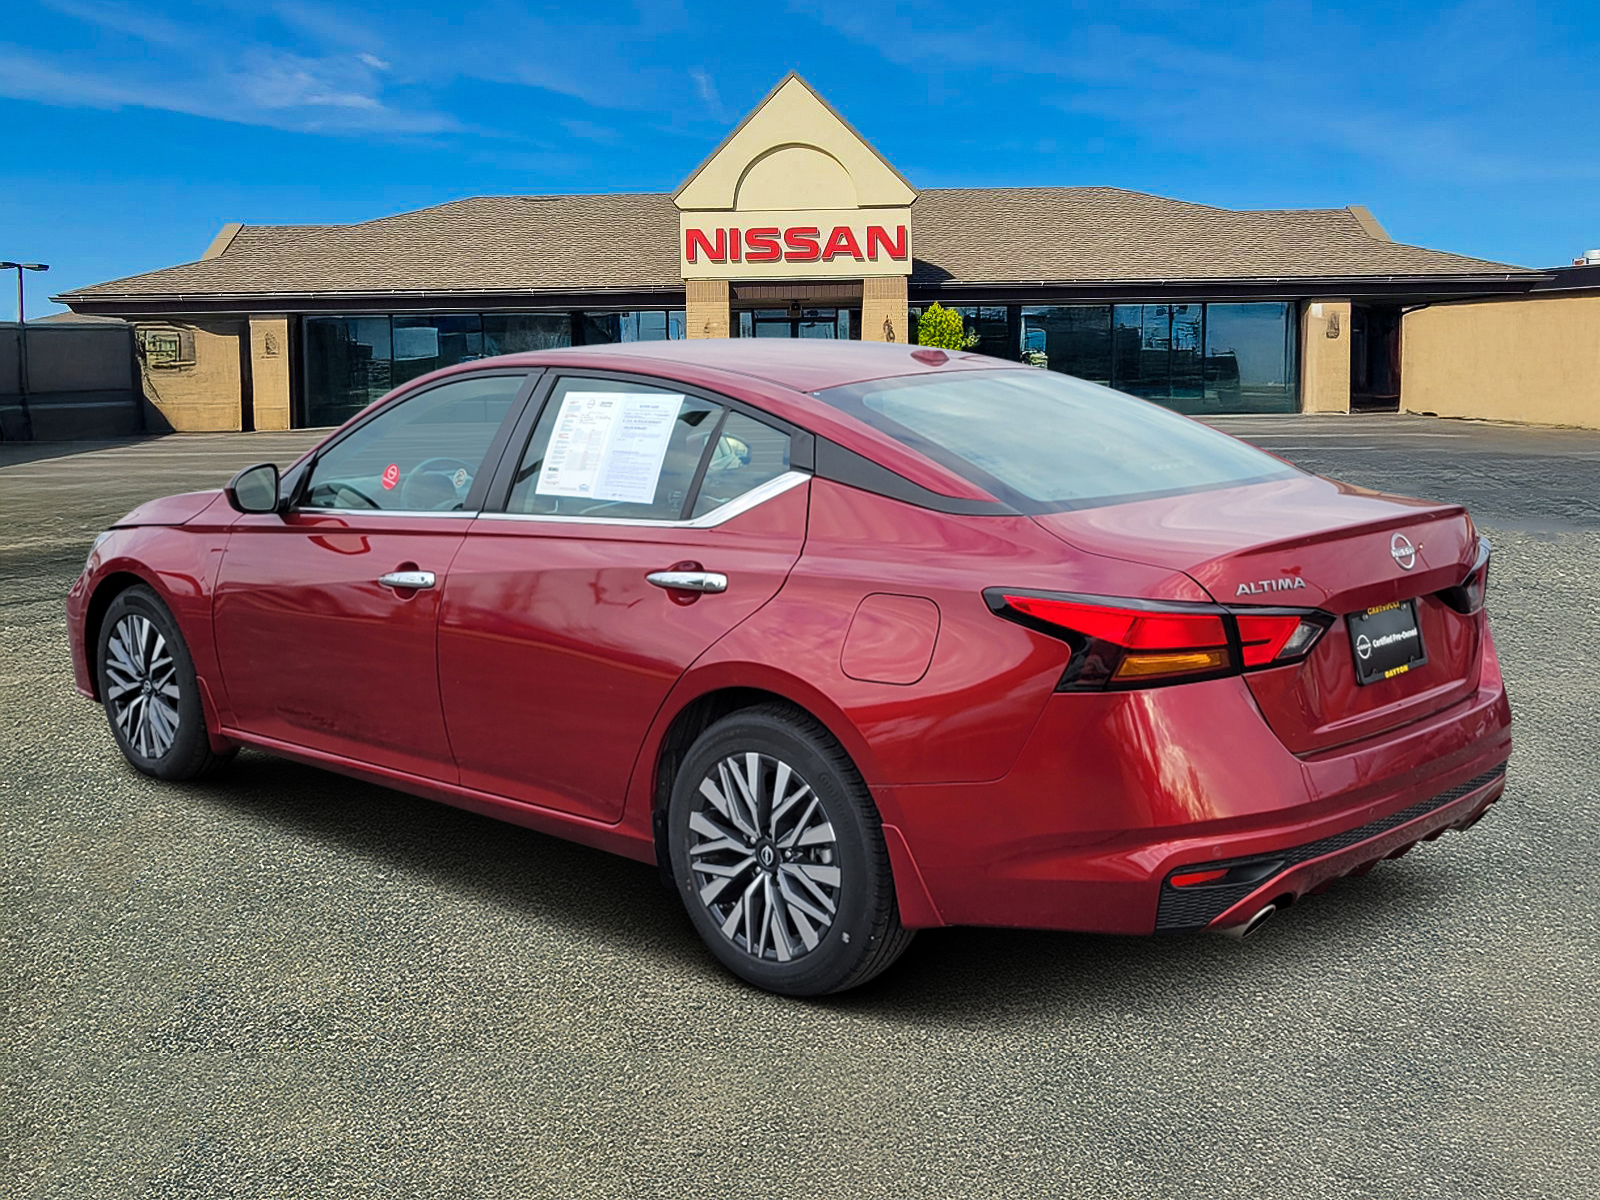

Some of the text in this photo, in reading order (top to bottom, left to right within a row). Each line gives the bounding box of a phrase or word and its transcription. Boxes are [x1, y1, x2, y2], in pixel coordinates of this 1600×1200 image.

[686, 225, 908, 264] NISSAN
[1236, 577, 1306, 596] ALTIMA
[1372, 627, 1418, 648] Certified Pre-Owned
[1384, 664, 1409, 678] DAYTON
